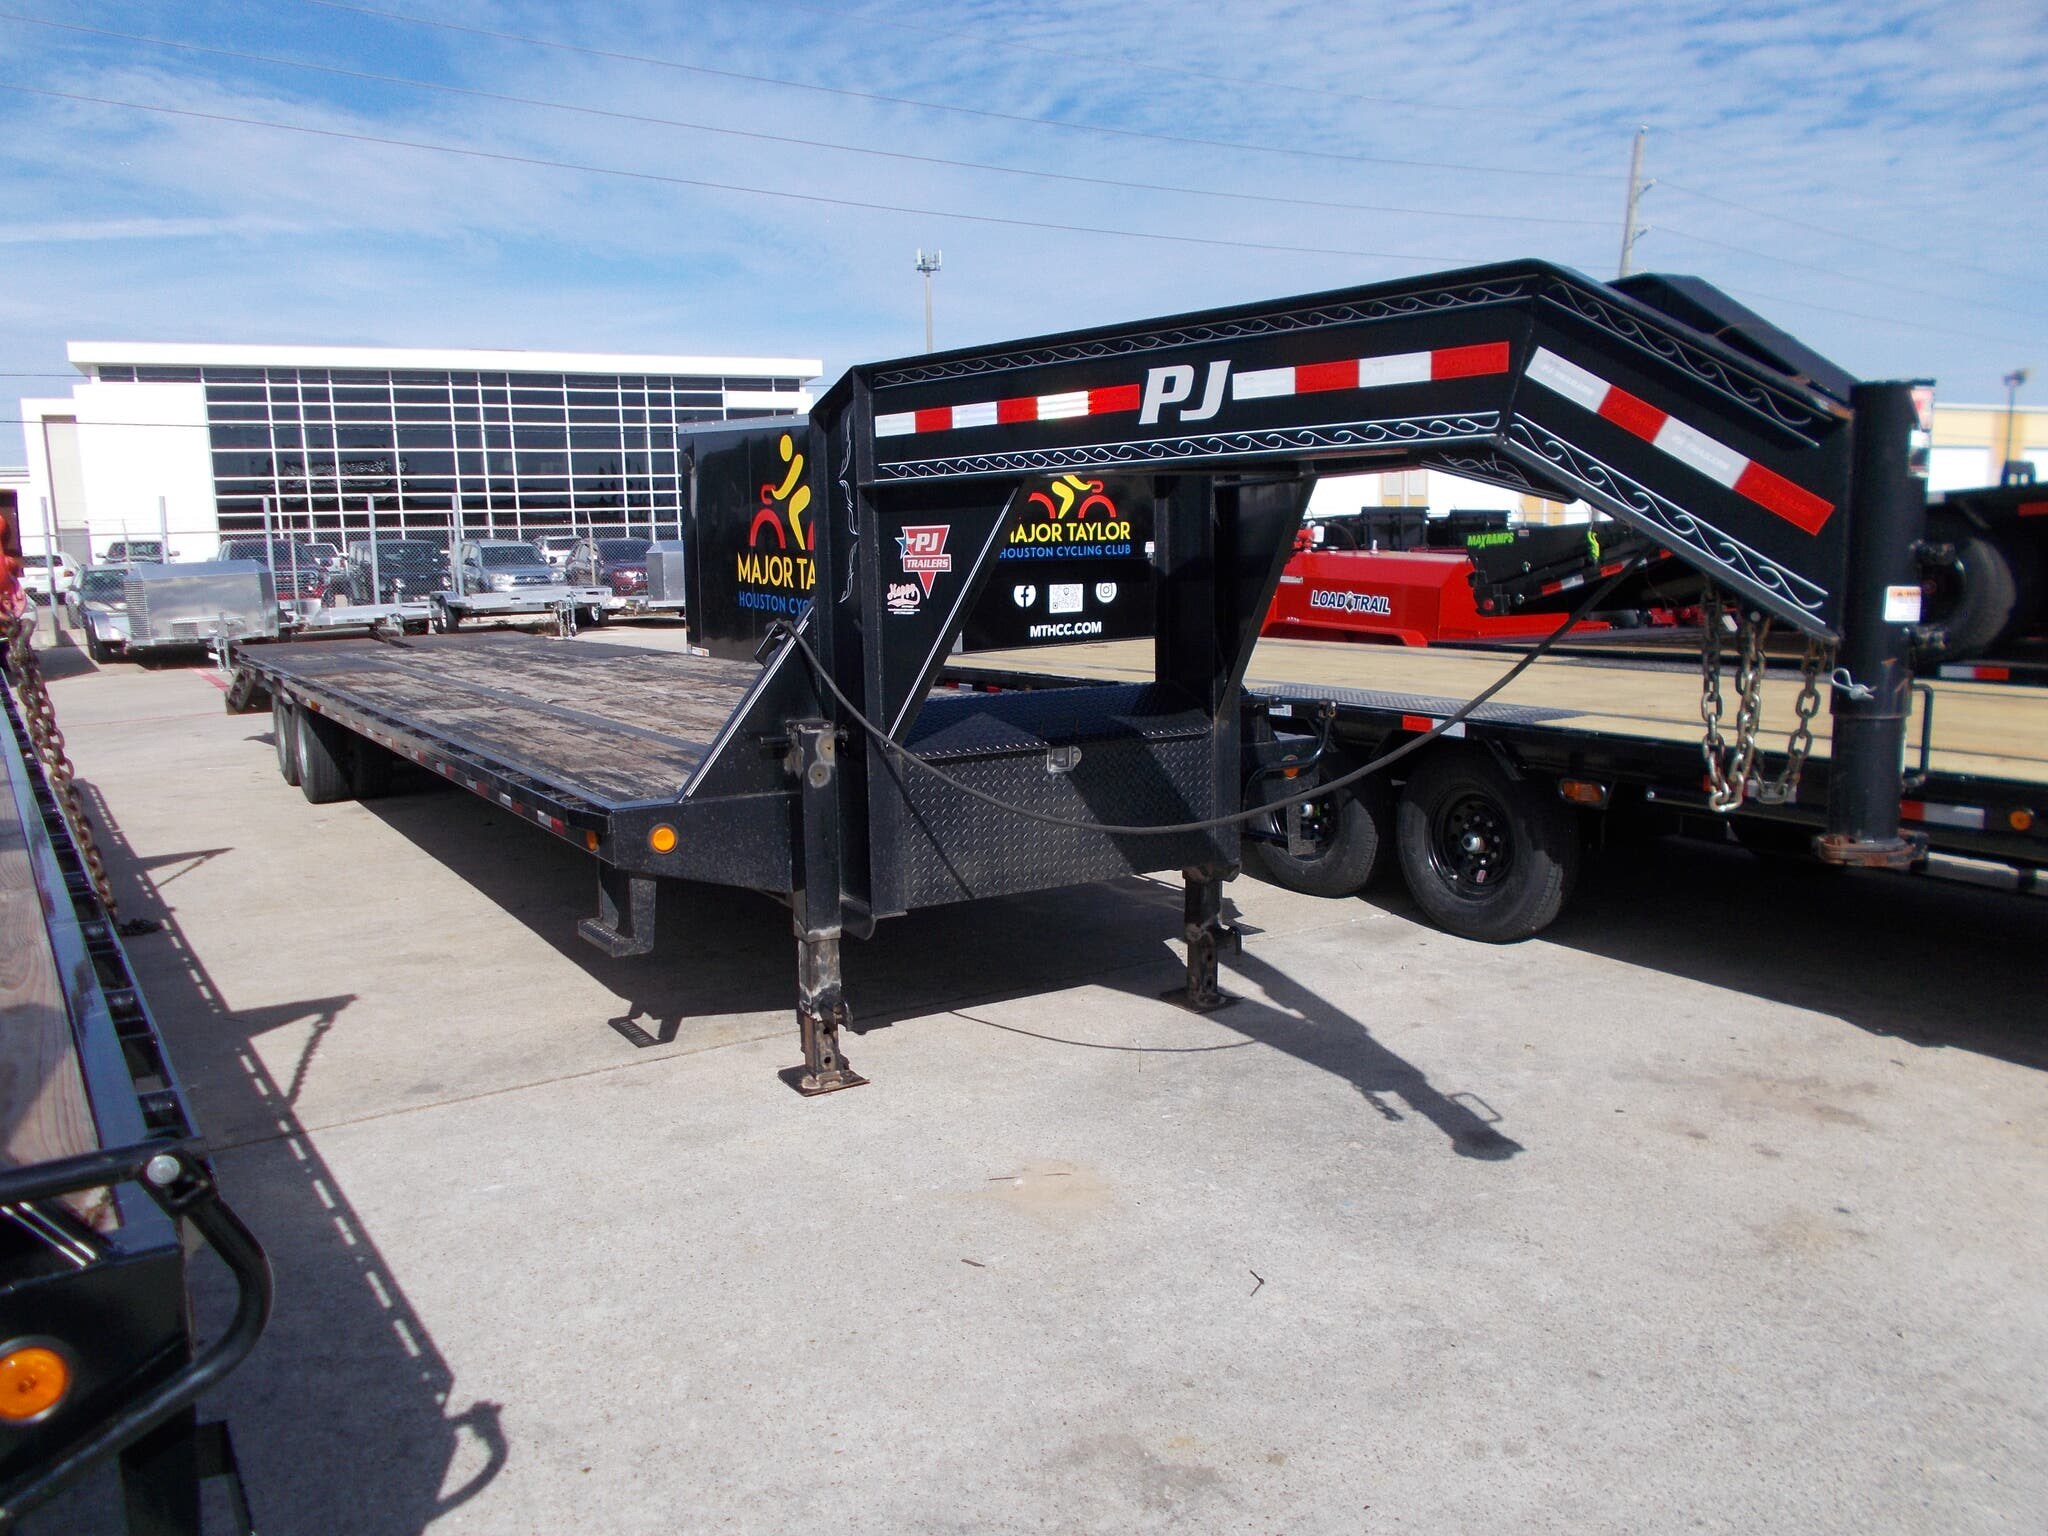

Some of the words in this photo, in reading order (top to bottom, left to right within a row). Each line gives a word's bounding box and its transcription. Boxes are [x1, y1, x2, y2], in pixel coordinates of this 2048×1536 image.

[1139, 360, 1231, 424] PJ
[1066, 521, 1131, 541] TAYLOR
[1467, 532, 1514, 548] MAXRAMPS
[915, 533, 939, 552] PJ
[1057, 545, 1102, 557] CYCLING
[1105, 544, 1131, 555] CLUB
[737, 552, 794, 586] MAJOR
[907, 559, 948, 568] TRAILERS
[739, 591, 786, 612] HOUSTON
[1311, 590, 1346, 609] LOAD
[1353, 594, 1391, 614] TRAIL
[1030, 621, 1102, 638] MTHCC.COM
